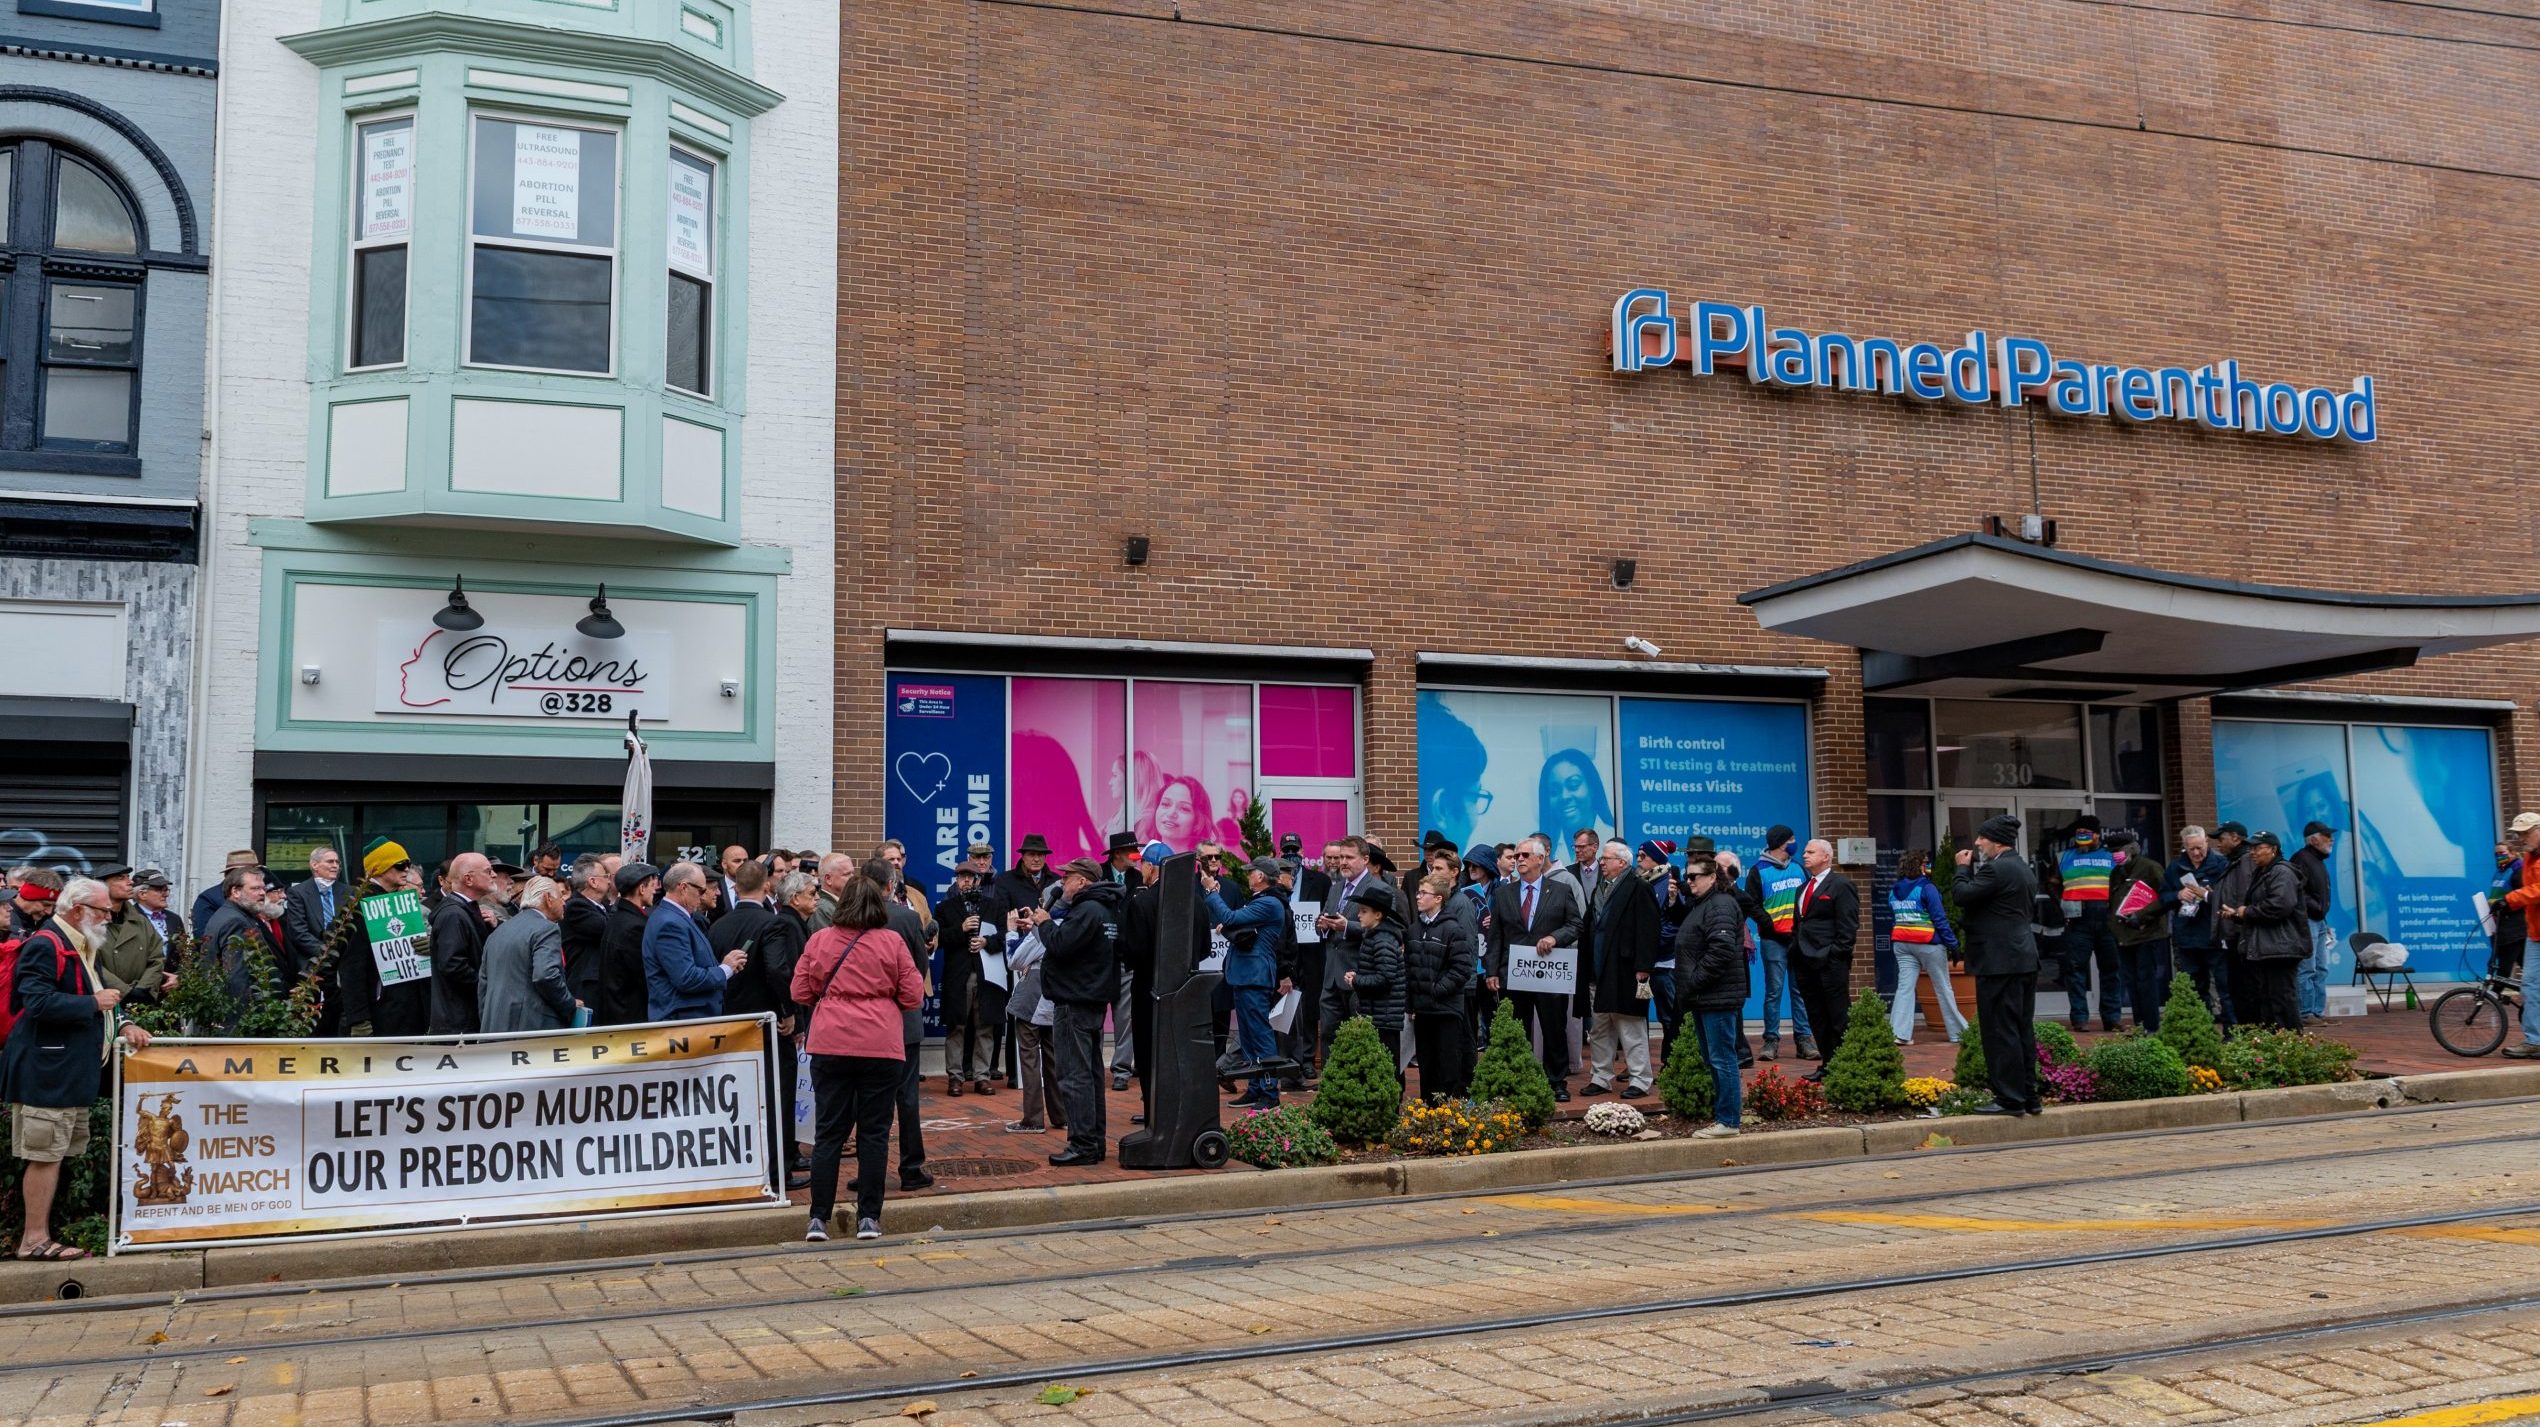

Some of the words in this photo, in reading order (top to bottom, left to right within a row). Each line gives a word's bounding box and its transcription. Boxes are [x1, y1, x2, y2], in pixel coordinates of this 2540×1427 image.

[383, 137, 395, 147] FREE
[536, 132, 558, 142] FREE
[373, 146, 404, 160] PREGNANCY
[517, 143, 578, 156] ULTRASOUND
[383, 160, 395, 170] TEST
[375, 184, 402, 197] ABORTION
[519, 179, 574, 193] ABORTION
[382, 197, 393, 208] PILL
[535, 194, 557, 205] PILL
[375, 208, 400, 221] REVERSAL
[521, 206, 571, 219] REVERSAL
[676, 213, 698, 230] ABORTION
[1690, 301, 1991, 403] Planned
[1996, 336, 2378, 443] Parenthood
[444, 635, 648, 705] Options
[901, 688, 929, 696] Security
[540, 692, 612, 715] @328
[1639, 736, 1672, 750] Birth
[1676, 738, 1725, 750] control
[1640, 758, 1660, 770] STI
[1664, 758, 1713, 774] testing
[1716, 760, 1726, 772] &
[1730, 761, 1797, 773] treatment
[1993, 763, 2033, 785] 330
[1640, 779, 1702, 793] Wellness
[1706, 780, 1743, 793] Visits
[1641, 801, 1685, 814] Breast
[1688, 805, 1732, 814] exams
[1642, 822, 1689, 835] Cancer
[1692, 823, 1767, 838] Screenings
[936, 807, 959, 870] ARE
[677, 846, 719, 863] 32
[2412, 893, 2429, 902] birth
[363, 897, 393, 920] LOVE
[394, 892, 419, 915] LIFE
[1294, 914, 1313, 923] RCE
[2400, 918, 2425, 928] gender
[2401, 931, 2438, 940] pregnancy
[380, 937, 417, 961] CHOO
[396, 958, 419, 979] LIFE
[1517, 959, 1569, 971] ENFORCE
[1511, 967, 1553, 980] CANON
[1555, 970, 1573, 981] 915
[174, 1054, 460, 1075] AMERICA
[511, 1034, 727, 1066] REPENT
[199, 1103, 249, 1126] THE
[334, 1095, 425, 1138] LET'S
[436, 1091, 525, 1132] STOP
[199, 1135, 276, 1160] MEN'S
[308, 1149, 388, 1194] OUR
[400, 1138, 564, 1189] PREBORN
[575, 1124, 753, 1176] CHILDREN!
[199, 1168, 290, 1195] MARCH
[135, 1206, 179, 1219] REPENT
[181, 1205, 204, 1216] AND
[208, 1204, 222, 1214] BE
[224, 1202, 248, 1213] MEN
[251, 1201, 265, 1210] OF
[268, 1199, 292, 1209] GOD
